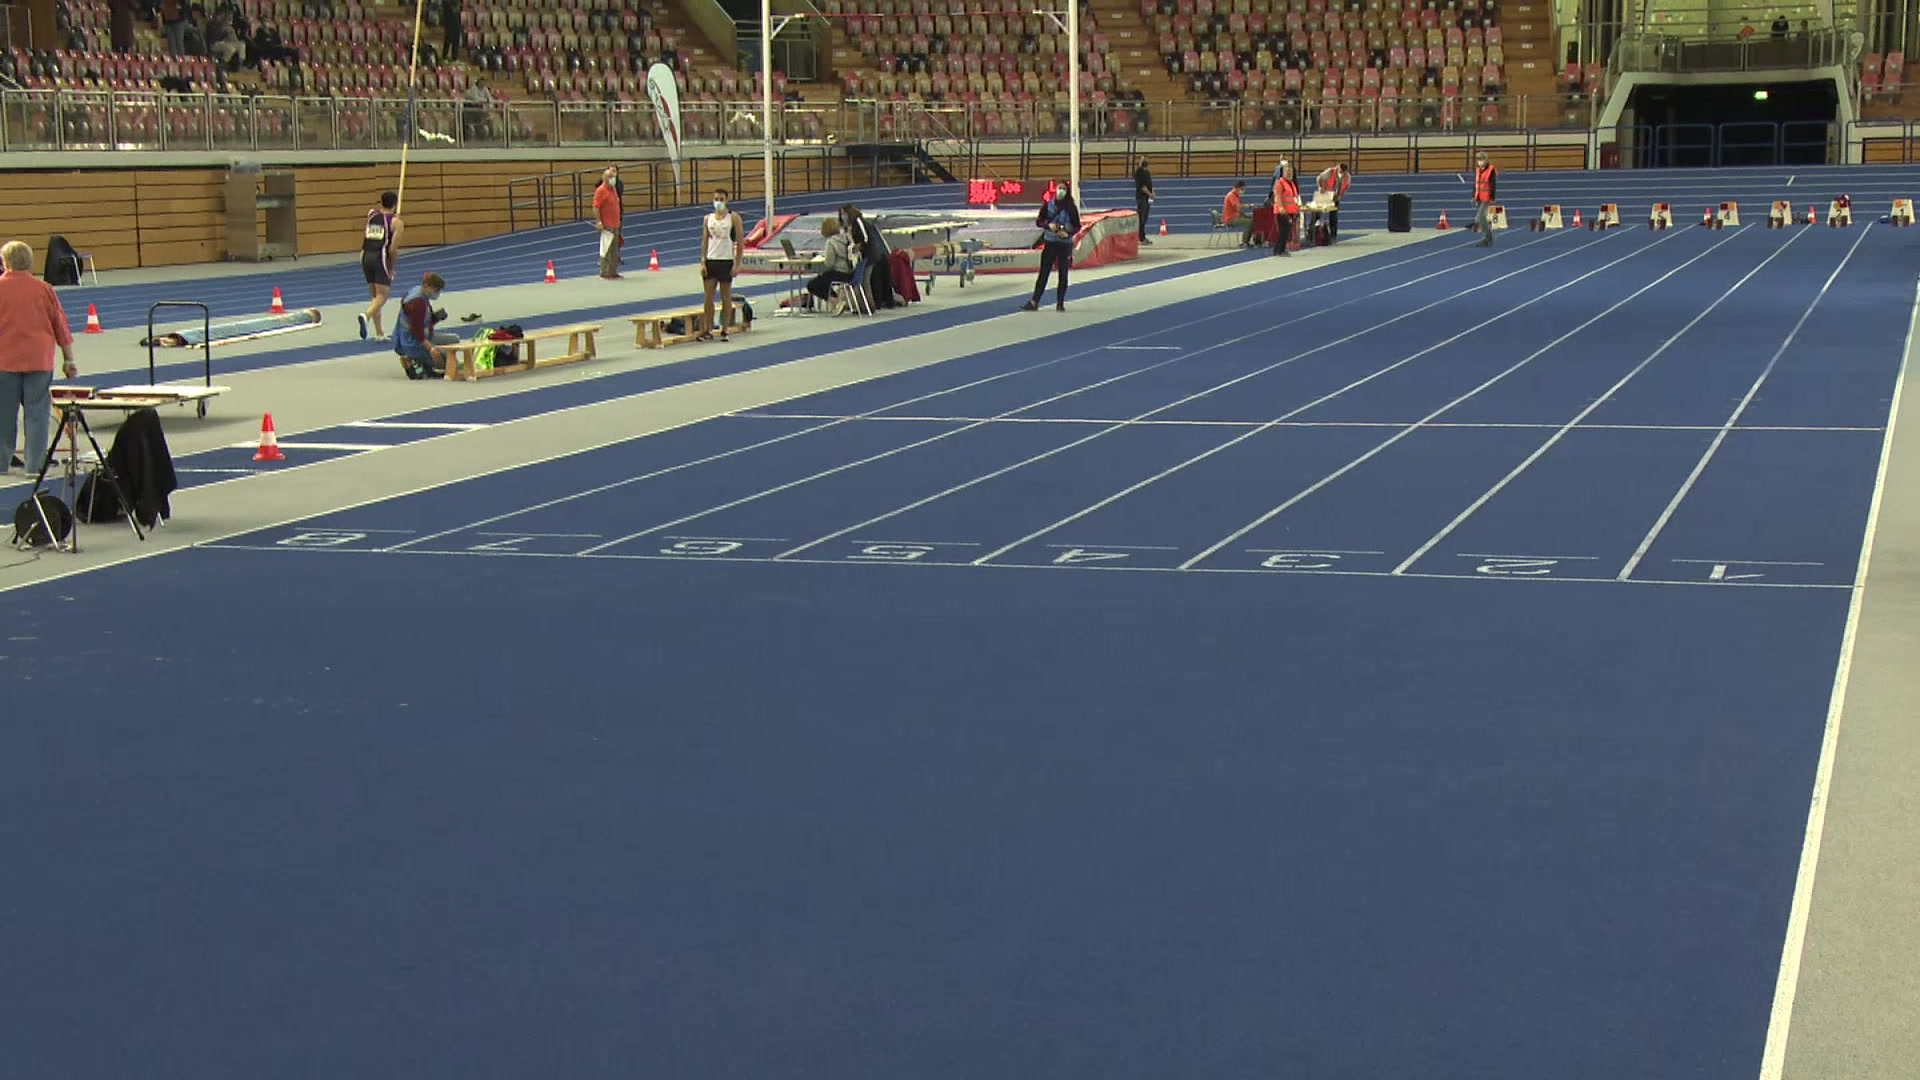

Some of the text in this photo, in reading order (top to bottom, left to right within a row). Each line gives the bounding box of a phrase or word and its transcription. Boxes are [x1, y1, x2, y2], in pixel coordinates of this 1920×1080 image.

[1492, 213, 1498, 224] 8
[1548, 212, 1554, 222] 7
[1724, 211, 1730, 220] 4
[276, 533, 367, 546] 8
[467, 537, 533, 550] 7
[660, 541, 743, 554] 6
[847, 545, 934, 560] 5
[1053, 549, 1130, 563] 4
[1261, 553, 1341, 568] 3
[1477, 558, 1558, 575] 2
[1709, 565, 1766, 580] 1
